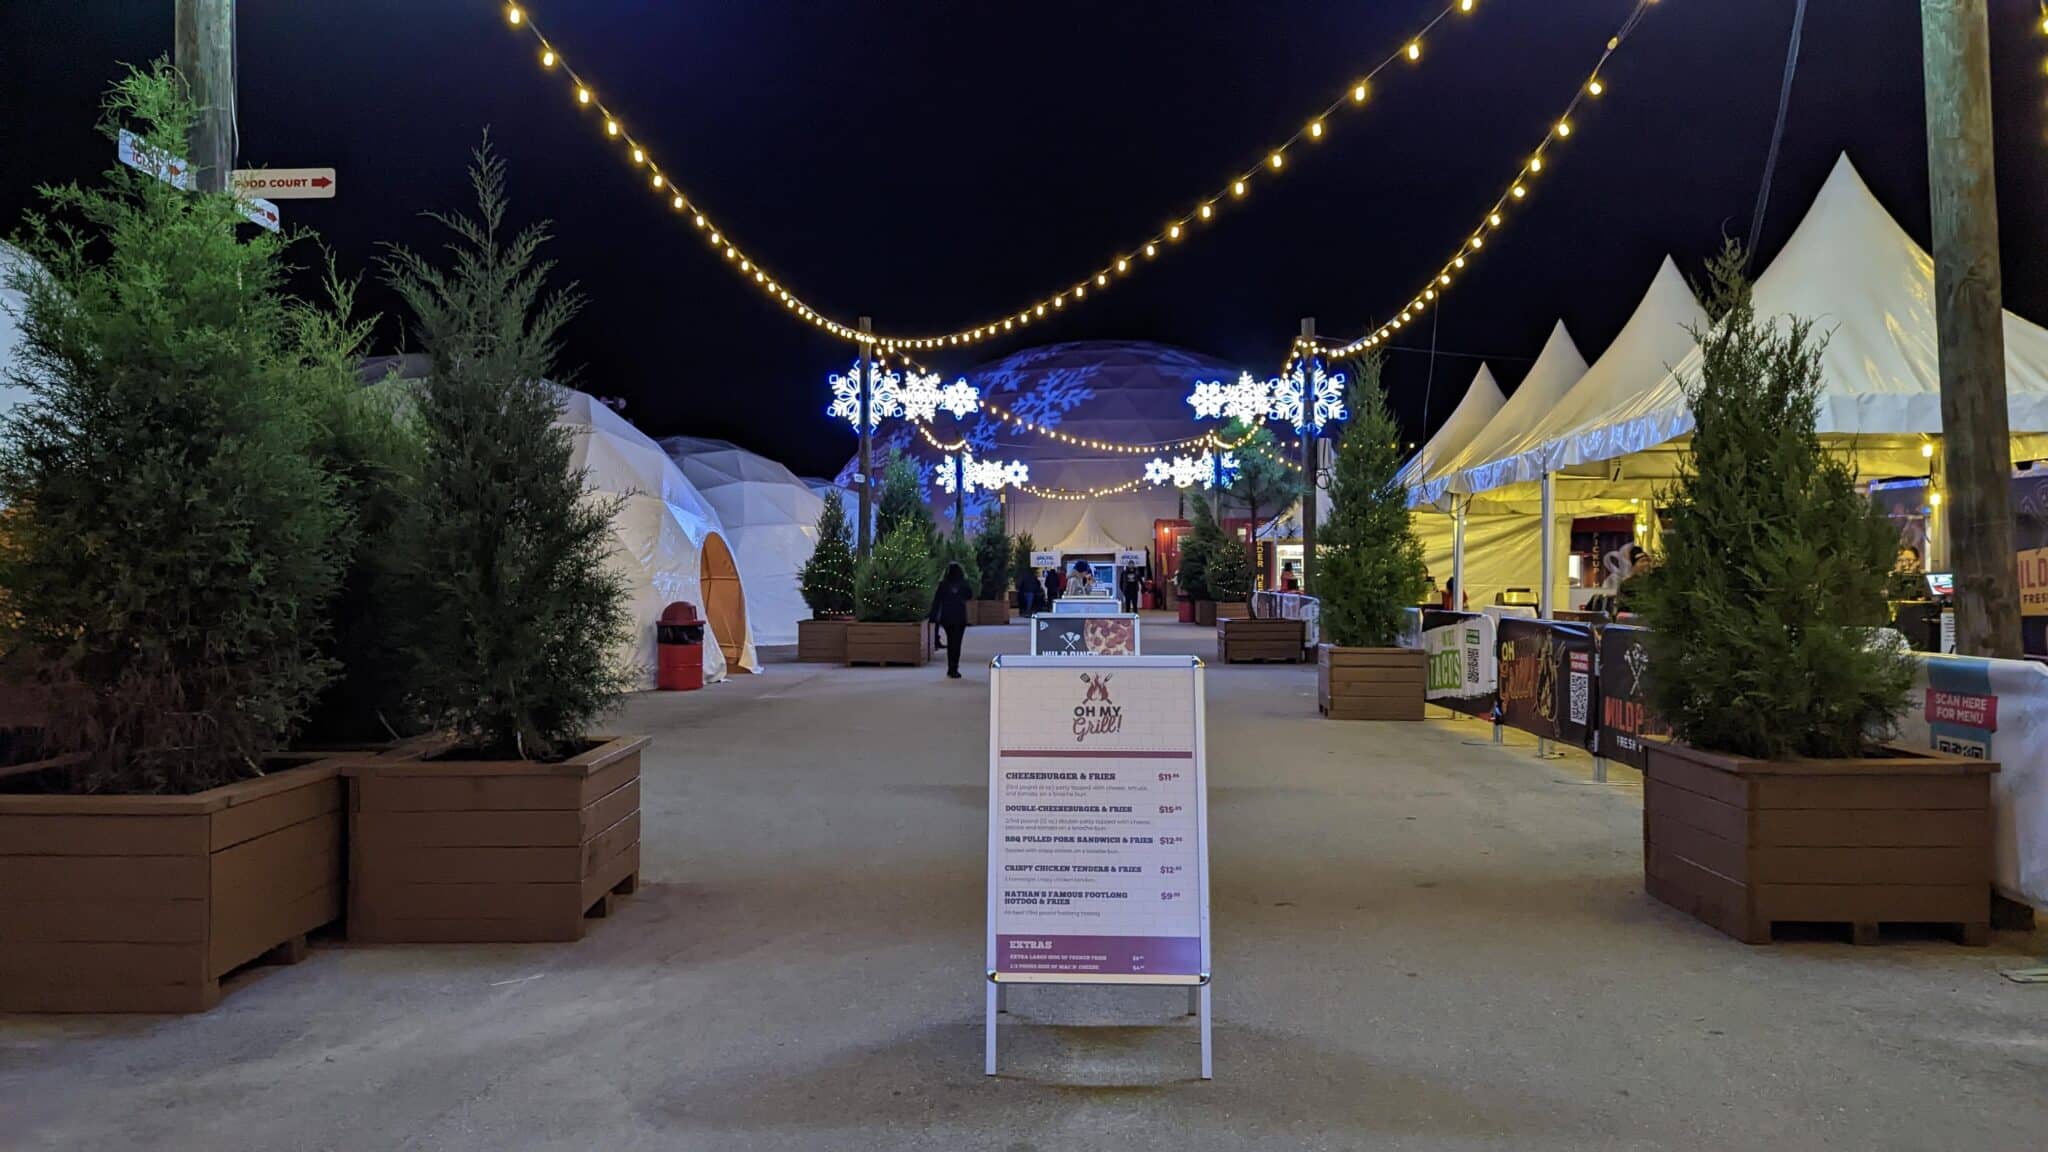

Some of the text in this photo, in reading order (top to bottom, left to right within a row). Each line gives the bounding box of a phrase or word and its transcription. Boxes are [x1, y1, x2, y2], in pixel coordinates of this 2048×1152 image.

[269, 179, 308, 188] COURT
[2019, 558, 2048, 590] ILD
[1501, 640, 1515, 661] OH
[1935, 693, 1988, 710] SCAN HERE
[1074, 706, 1121, 717] OH MY
[1936, 706, 1984, 724] FOR MENU
[1072, 714, 1122, 742] Grill!
[1006, 772, 1078, 780] CHEESEBURGER
[1009, 941, 1052, 949] EXTRAS
